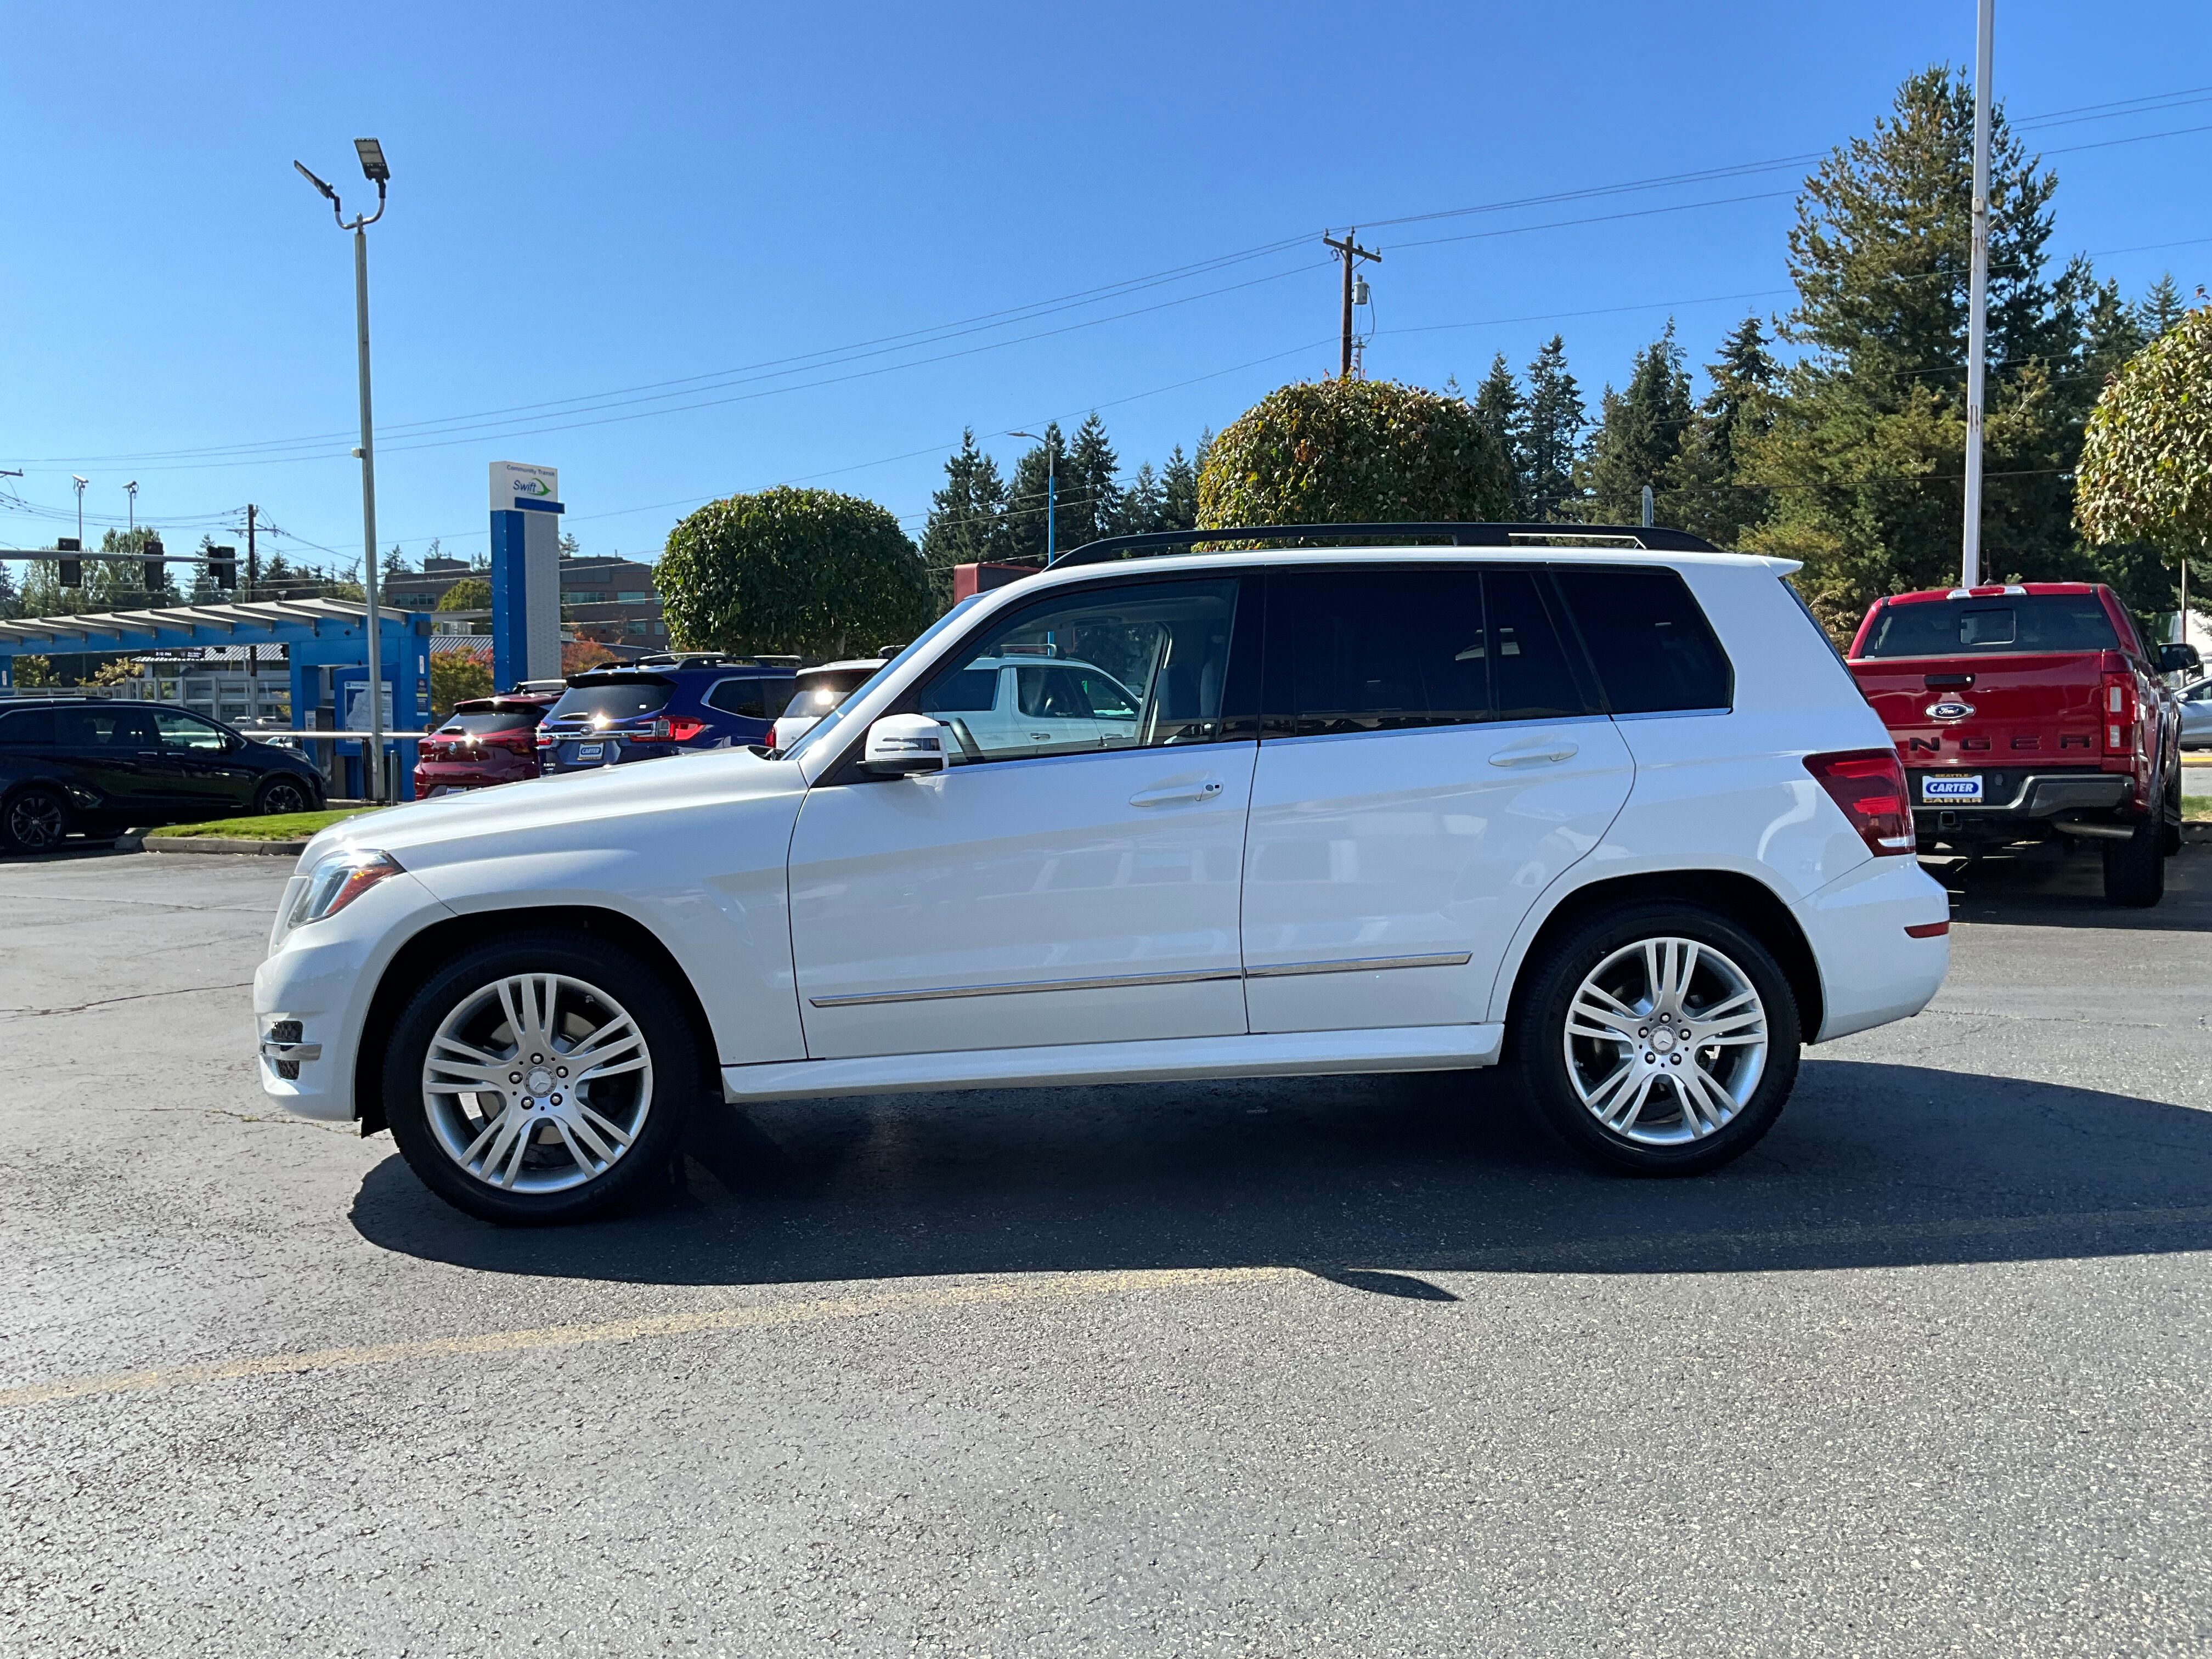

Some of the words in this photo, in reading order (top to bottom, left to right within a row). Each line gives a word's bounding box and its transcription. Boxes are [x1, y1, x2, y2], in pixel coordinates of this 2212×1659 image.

[507, 465, 537, 475] Community
[513, 479, 537, 493] Swift
[1909, 735, 2092, 751] NGER
[1929, 783, 1973, 793] CARTER
